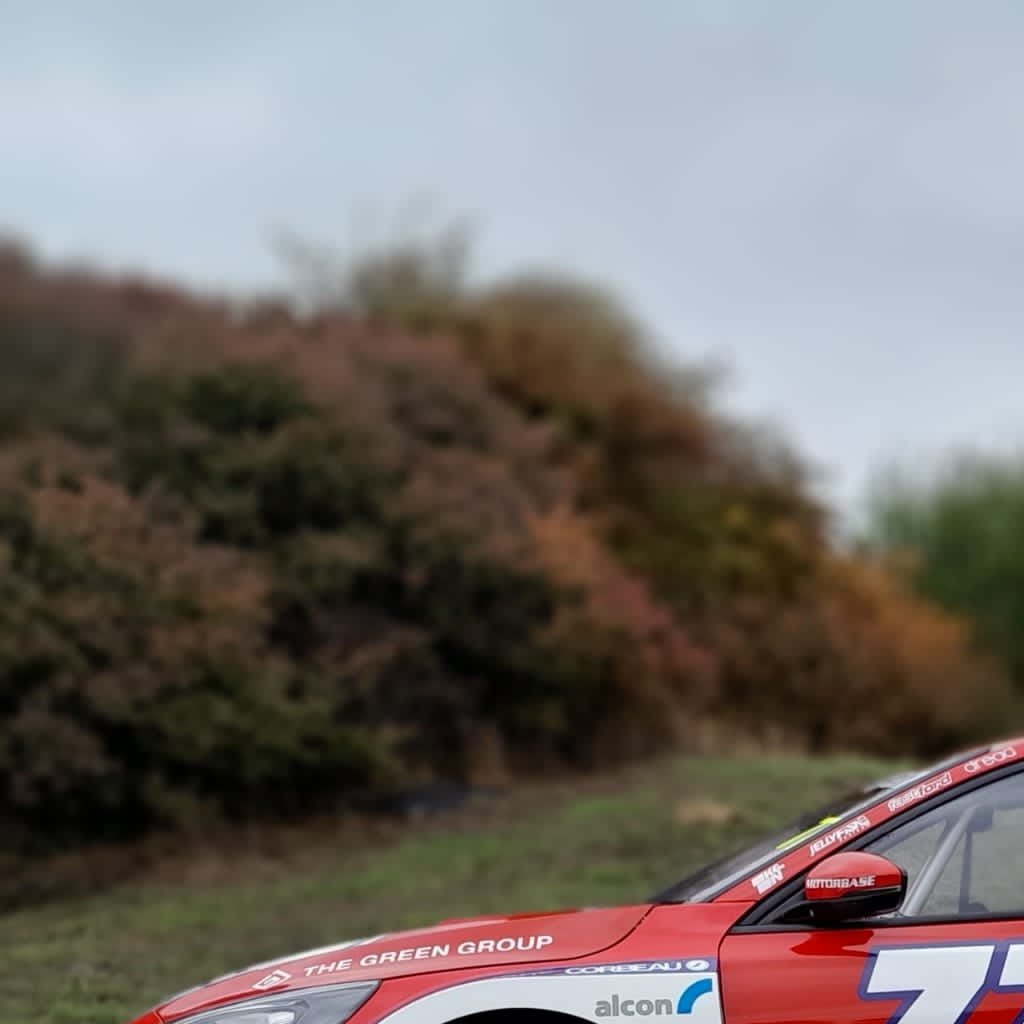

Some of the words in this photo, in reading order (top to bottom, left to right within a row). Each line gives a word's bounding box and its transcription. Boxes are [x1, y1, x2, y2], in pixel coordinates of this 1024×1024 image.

[303, 958, 353, 977] THE
[360, 944, 450, 967] GREEN
[457, 935, 553, 956] GROUP
[564, 960, 682, 975] CORBEAU
[594, 994, 673, 1017] alcon
